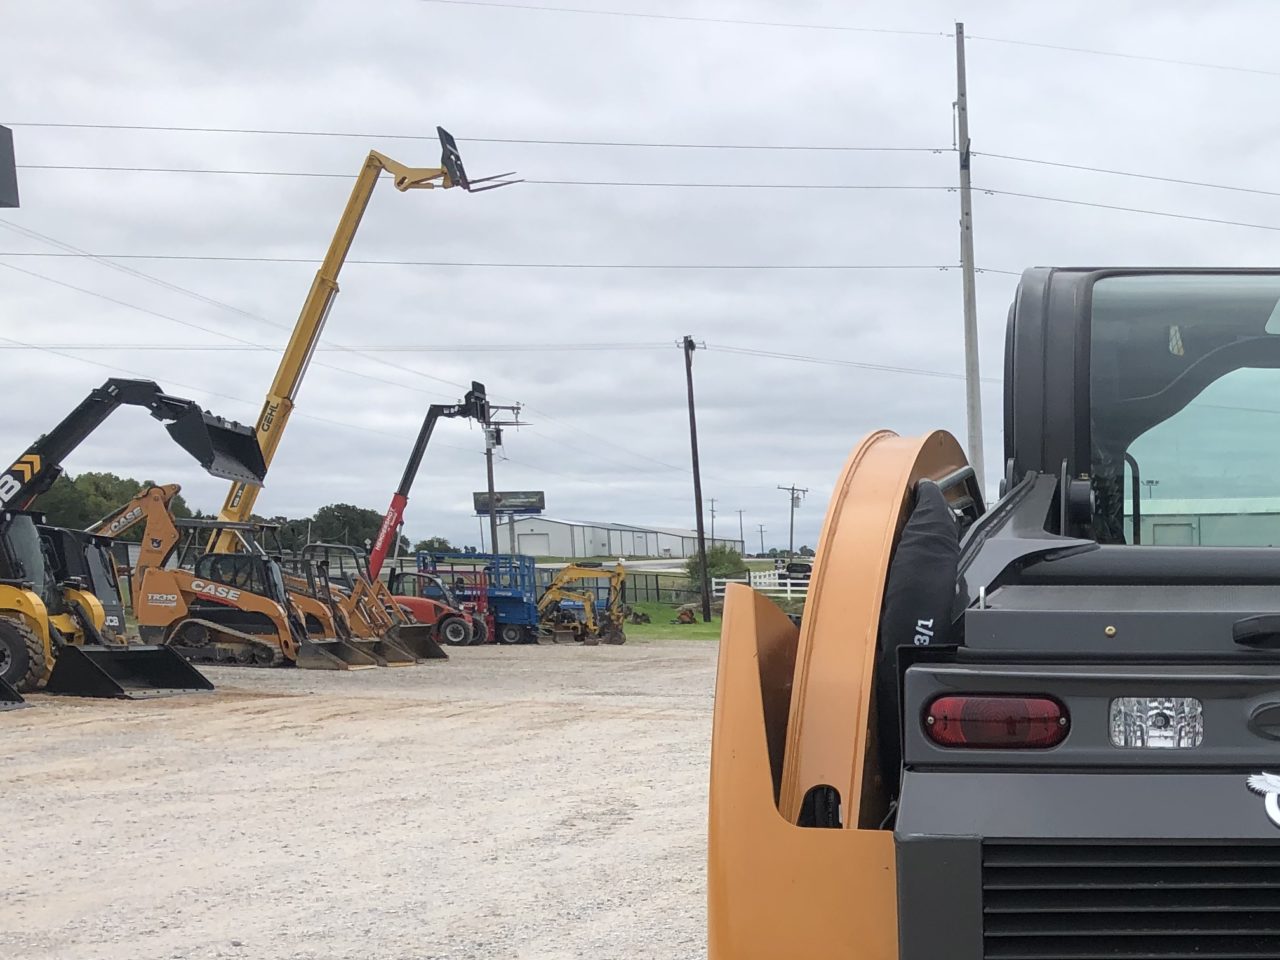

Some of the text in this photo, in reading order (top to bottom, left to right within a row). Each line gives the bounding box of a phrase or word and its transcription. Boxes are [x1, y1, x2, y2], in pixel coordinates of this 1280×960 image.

[261, 403, 279, 432] GEHL
[110, 506, 143, 532] CASE
[147, 593, 178, 601] TR310
[191, 580, 240, 601] CASE
[105, 615, 119, 626] JCB
